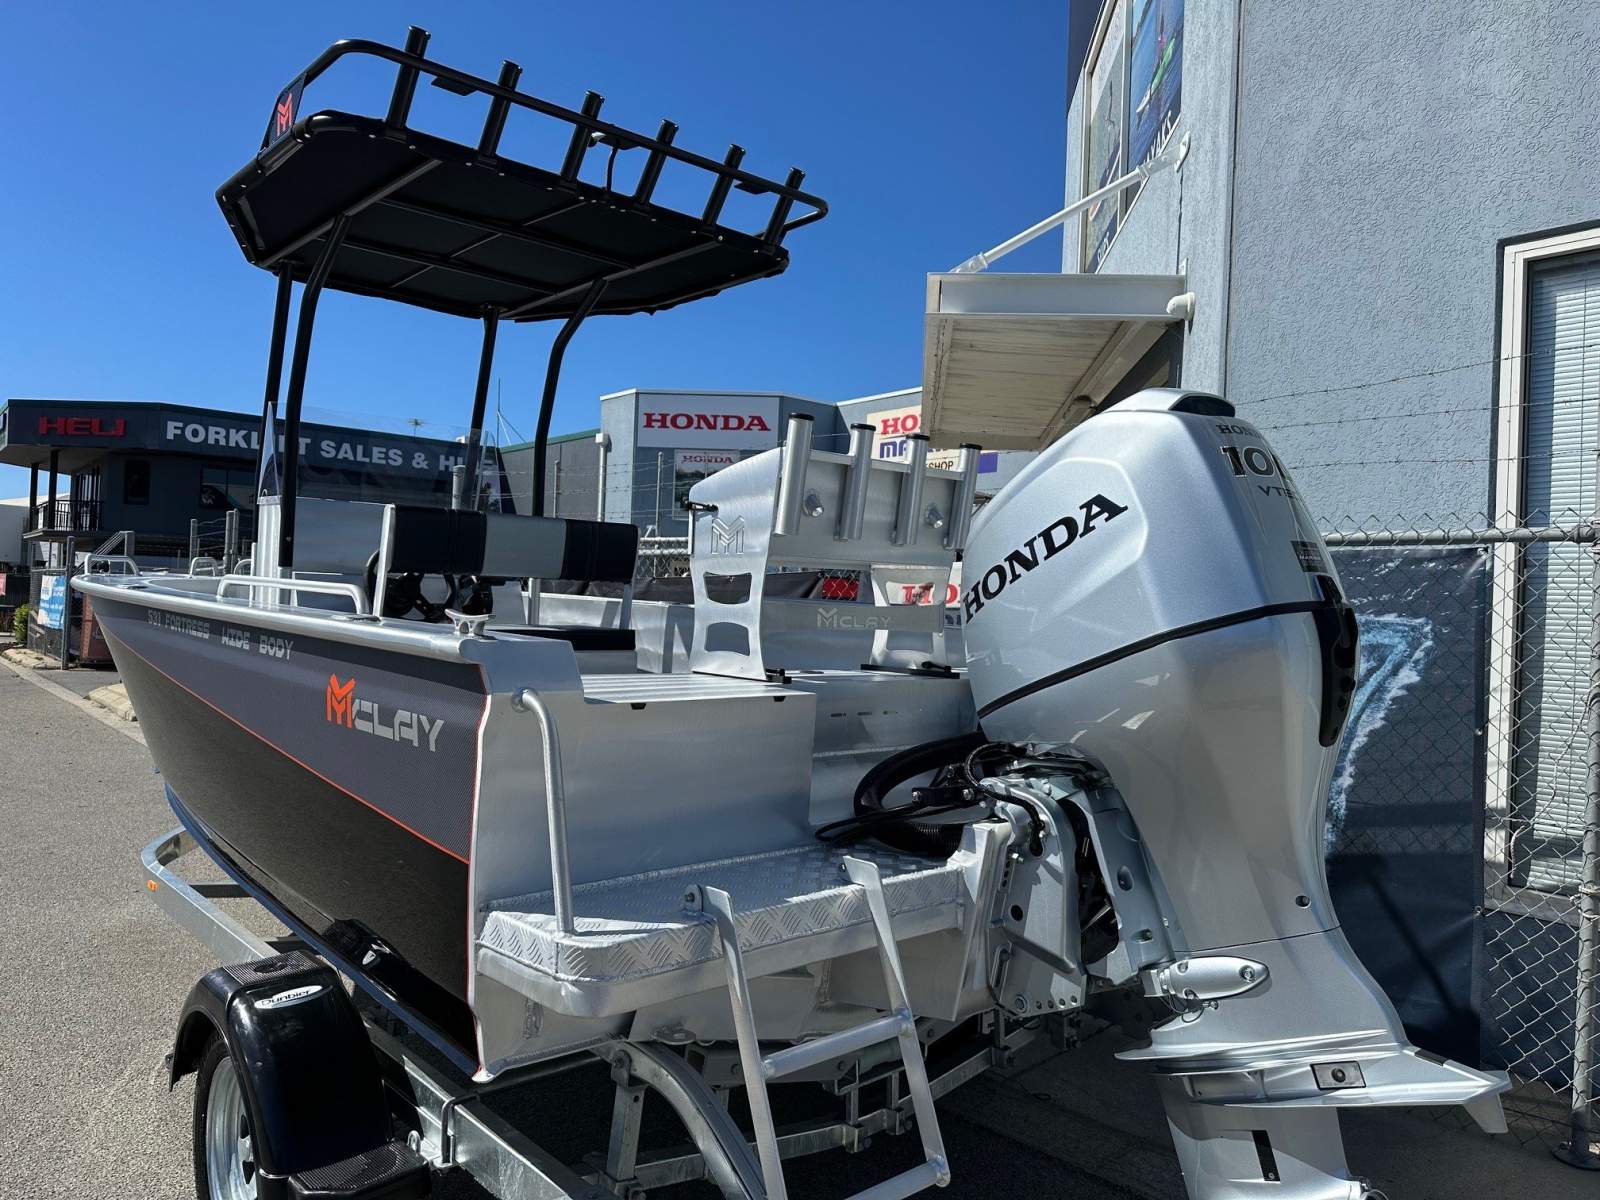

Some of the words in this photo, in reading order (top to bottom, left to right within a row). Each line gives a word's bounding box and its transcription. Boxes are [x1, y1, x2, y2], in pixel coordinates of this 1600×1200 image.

[39, 416, 126, 437] HELI
[643, 413, 771, 432] HONDA
[320, 437, 403, 466] SALES
[411, 452, 429, 470] &
[682, 455, 734, 464] HONDA
[965, 493, 1128, 624] HONDA
[165, 614, 210, 639] FORTRESS
[221, 627, 250, 650] WIDE
[259, 635, 293, 660] BODY
